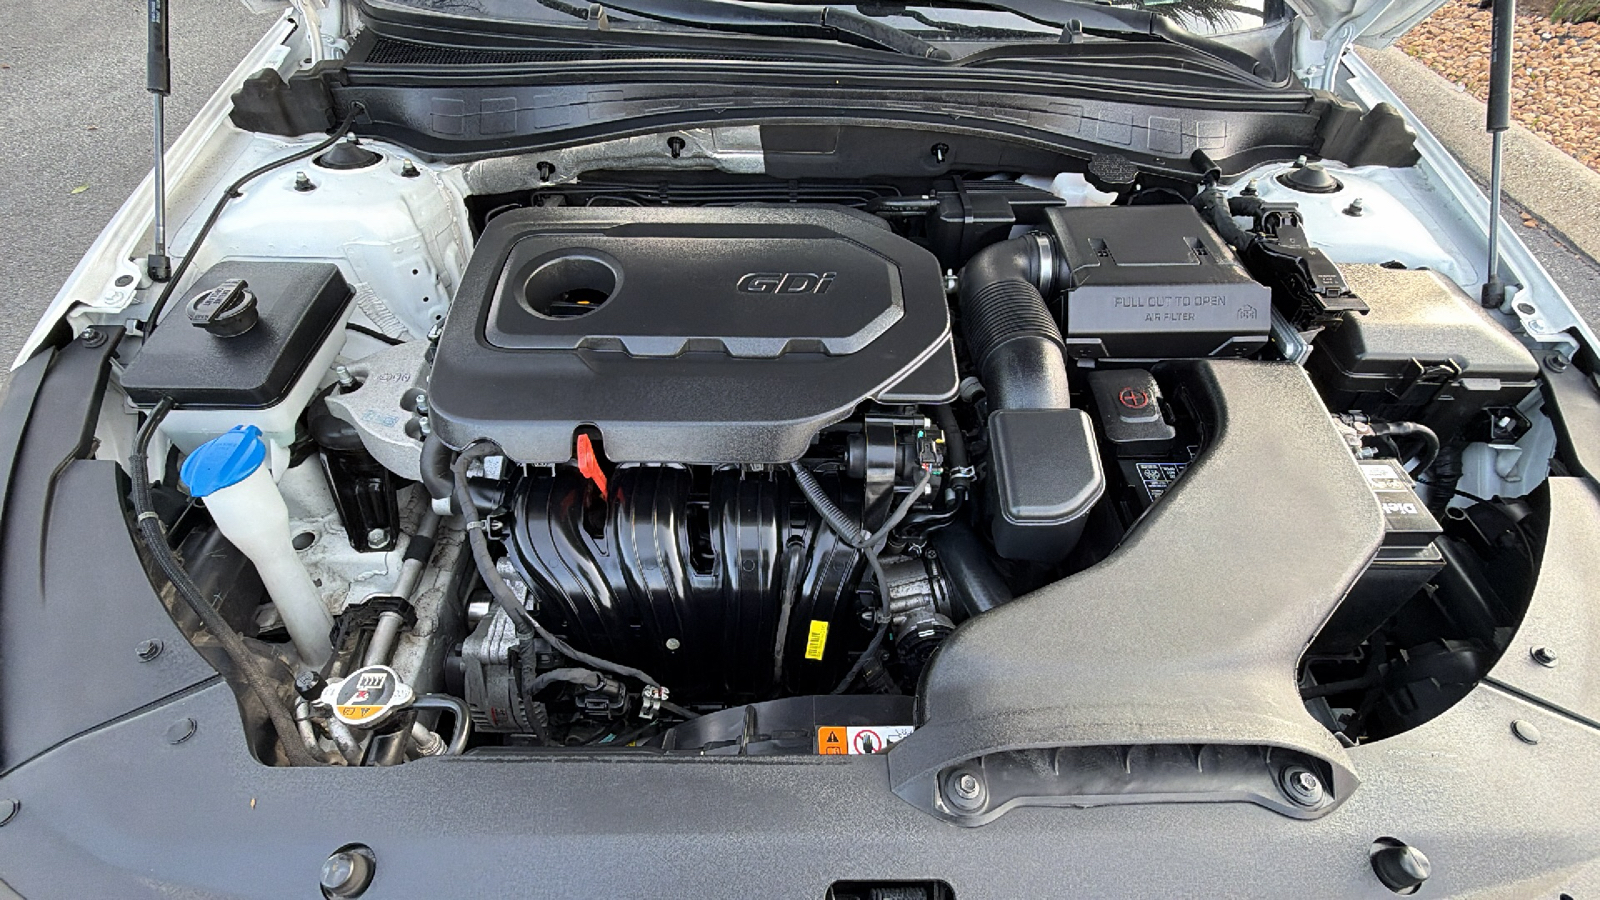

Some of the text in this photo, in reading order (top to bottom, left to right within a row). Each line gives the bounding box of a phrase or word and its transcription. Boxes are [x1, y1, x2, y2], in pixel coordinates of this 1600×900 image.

[736, 271, 837, 294] GDi
[1114, 295, 1226, 308] PULL OUT TO OPEN
[1145, 312, 1195, 322] AIR FILTER
